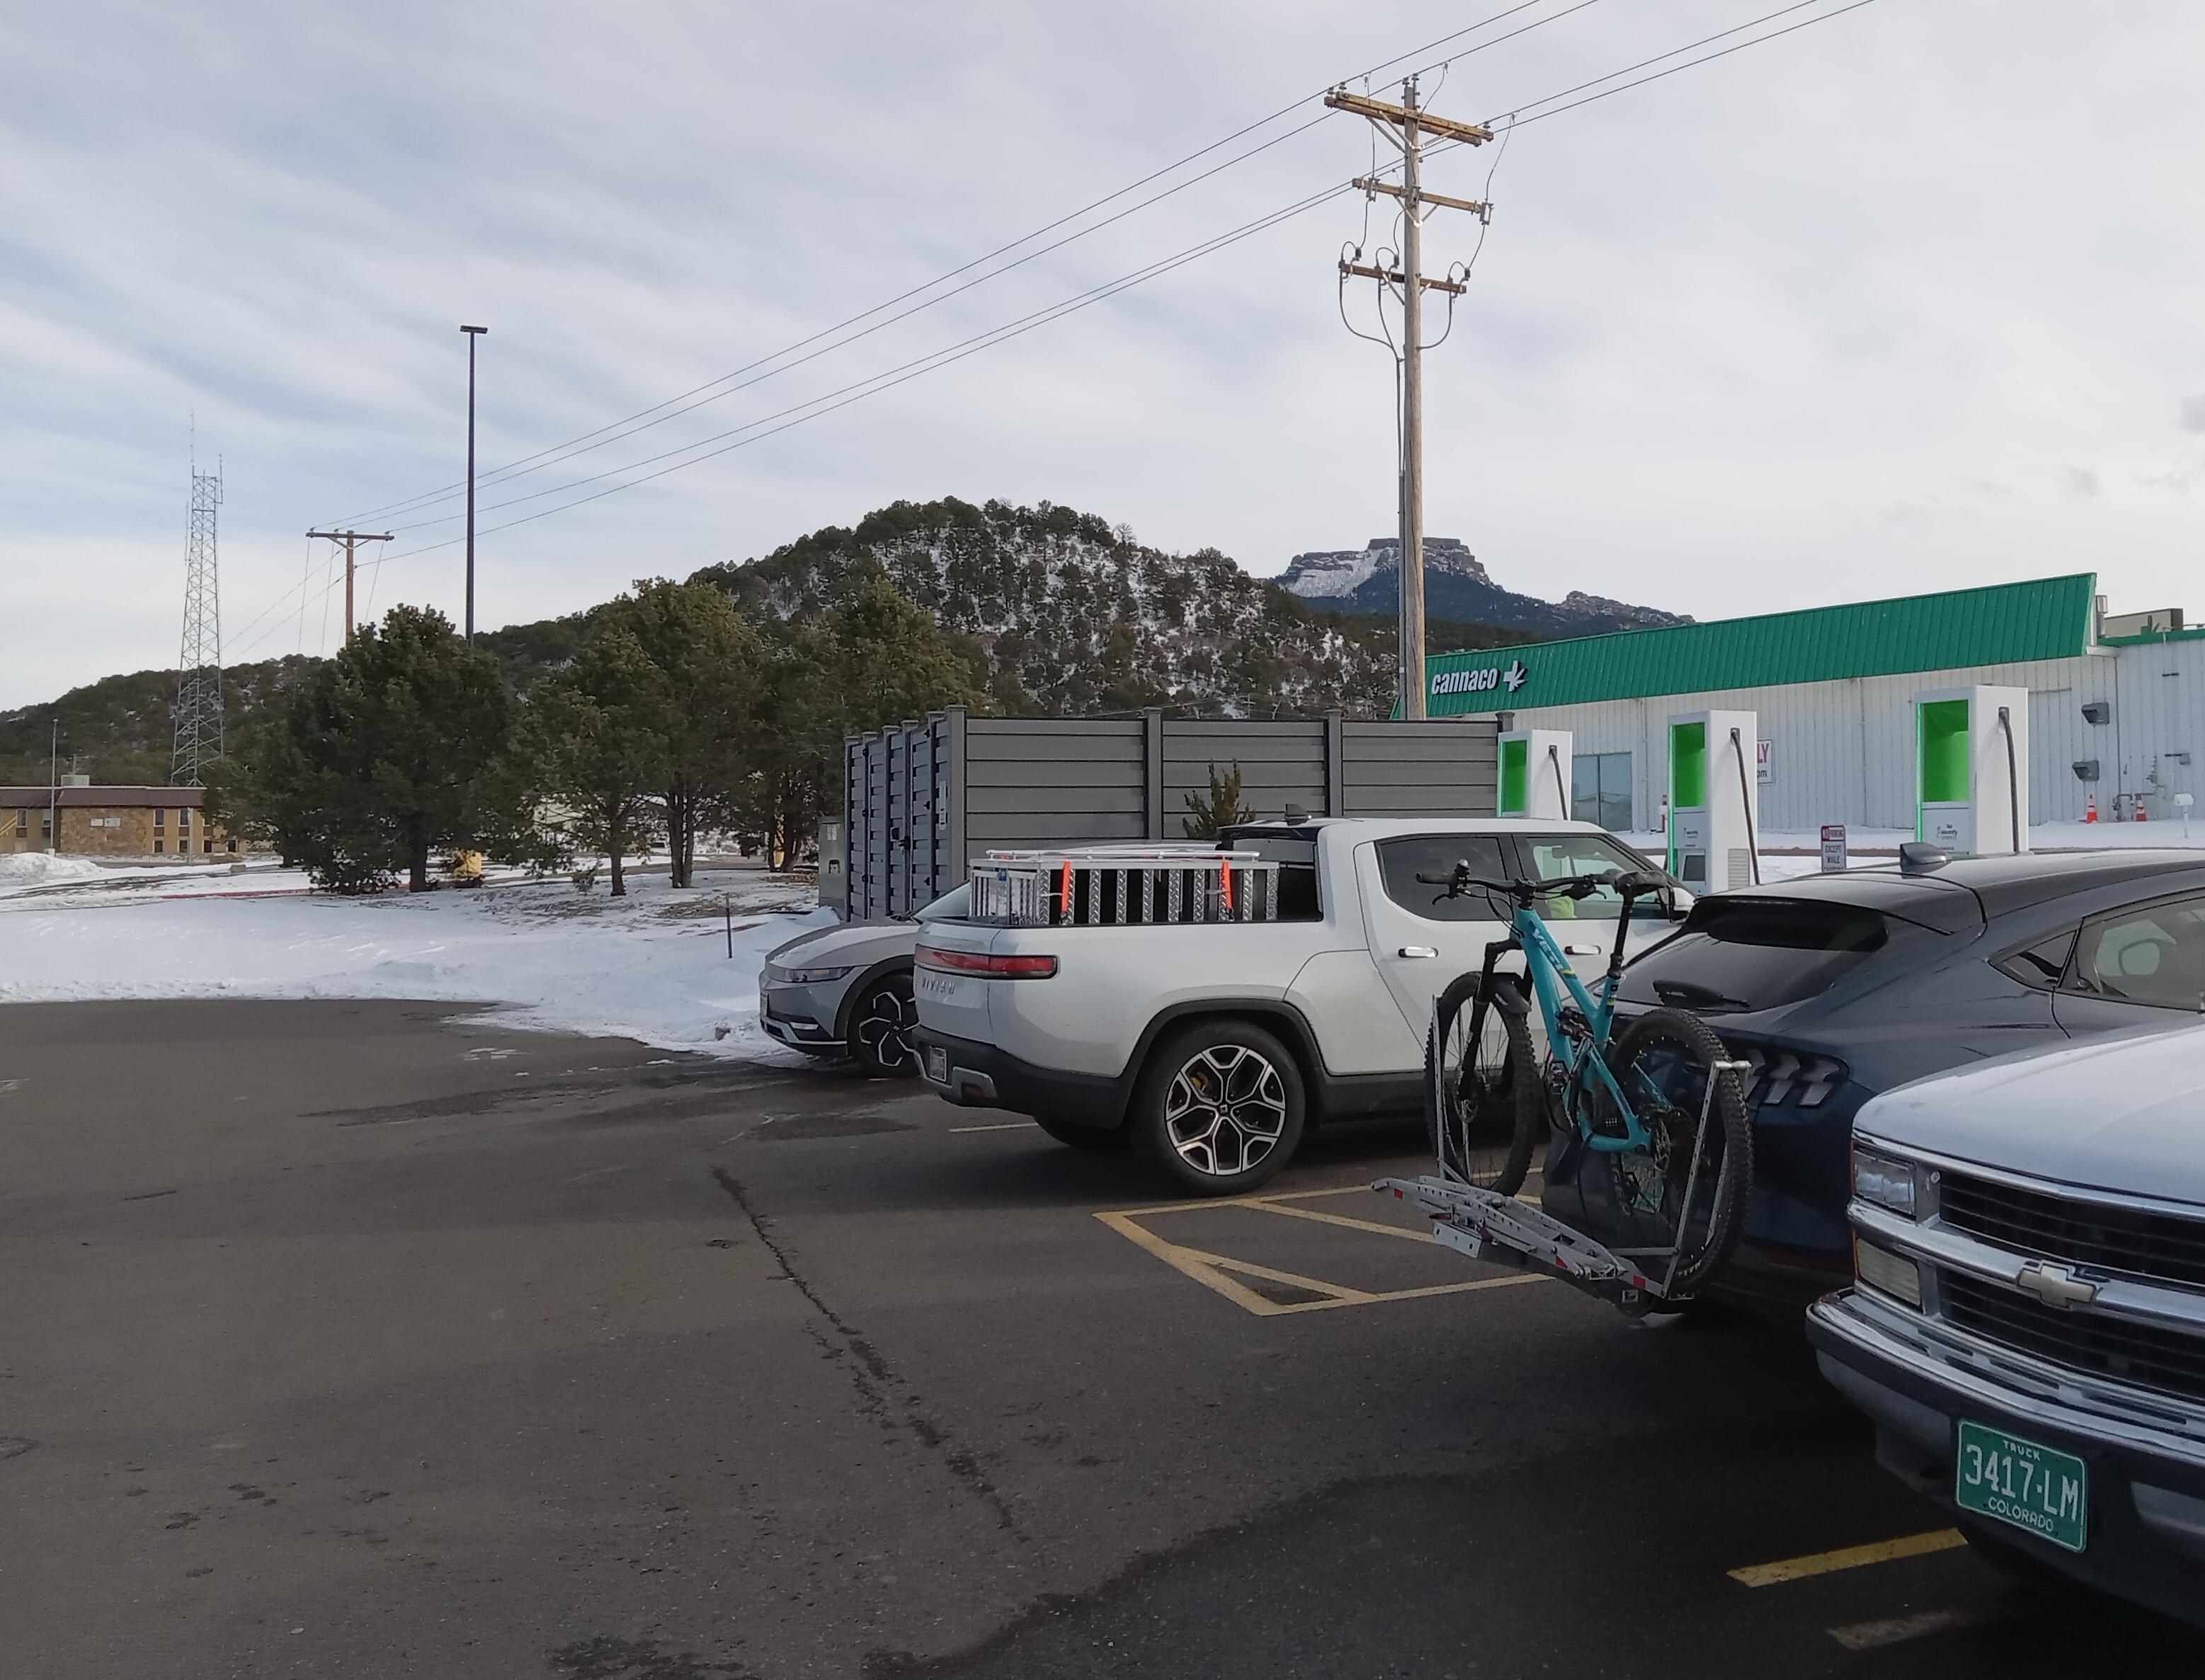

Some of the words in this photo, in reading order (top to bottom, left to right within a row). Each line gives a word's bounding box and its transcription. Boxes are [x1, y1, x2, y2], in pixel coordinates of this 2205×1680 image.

[1430, 668, 1498, 695] cannaco
[1757, 743, 1770, 764] LY
[2002, 1440, 2041, 1461] TRUCK
[1988, 1496, 2054, 1533] COLORADO
